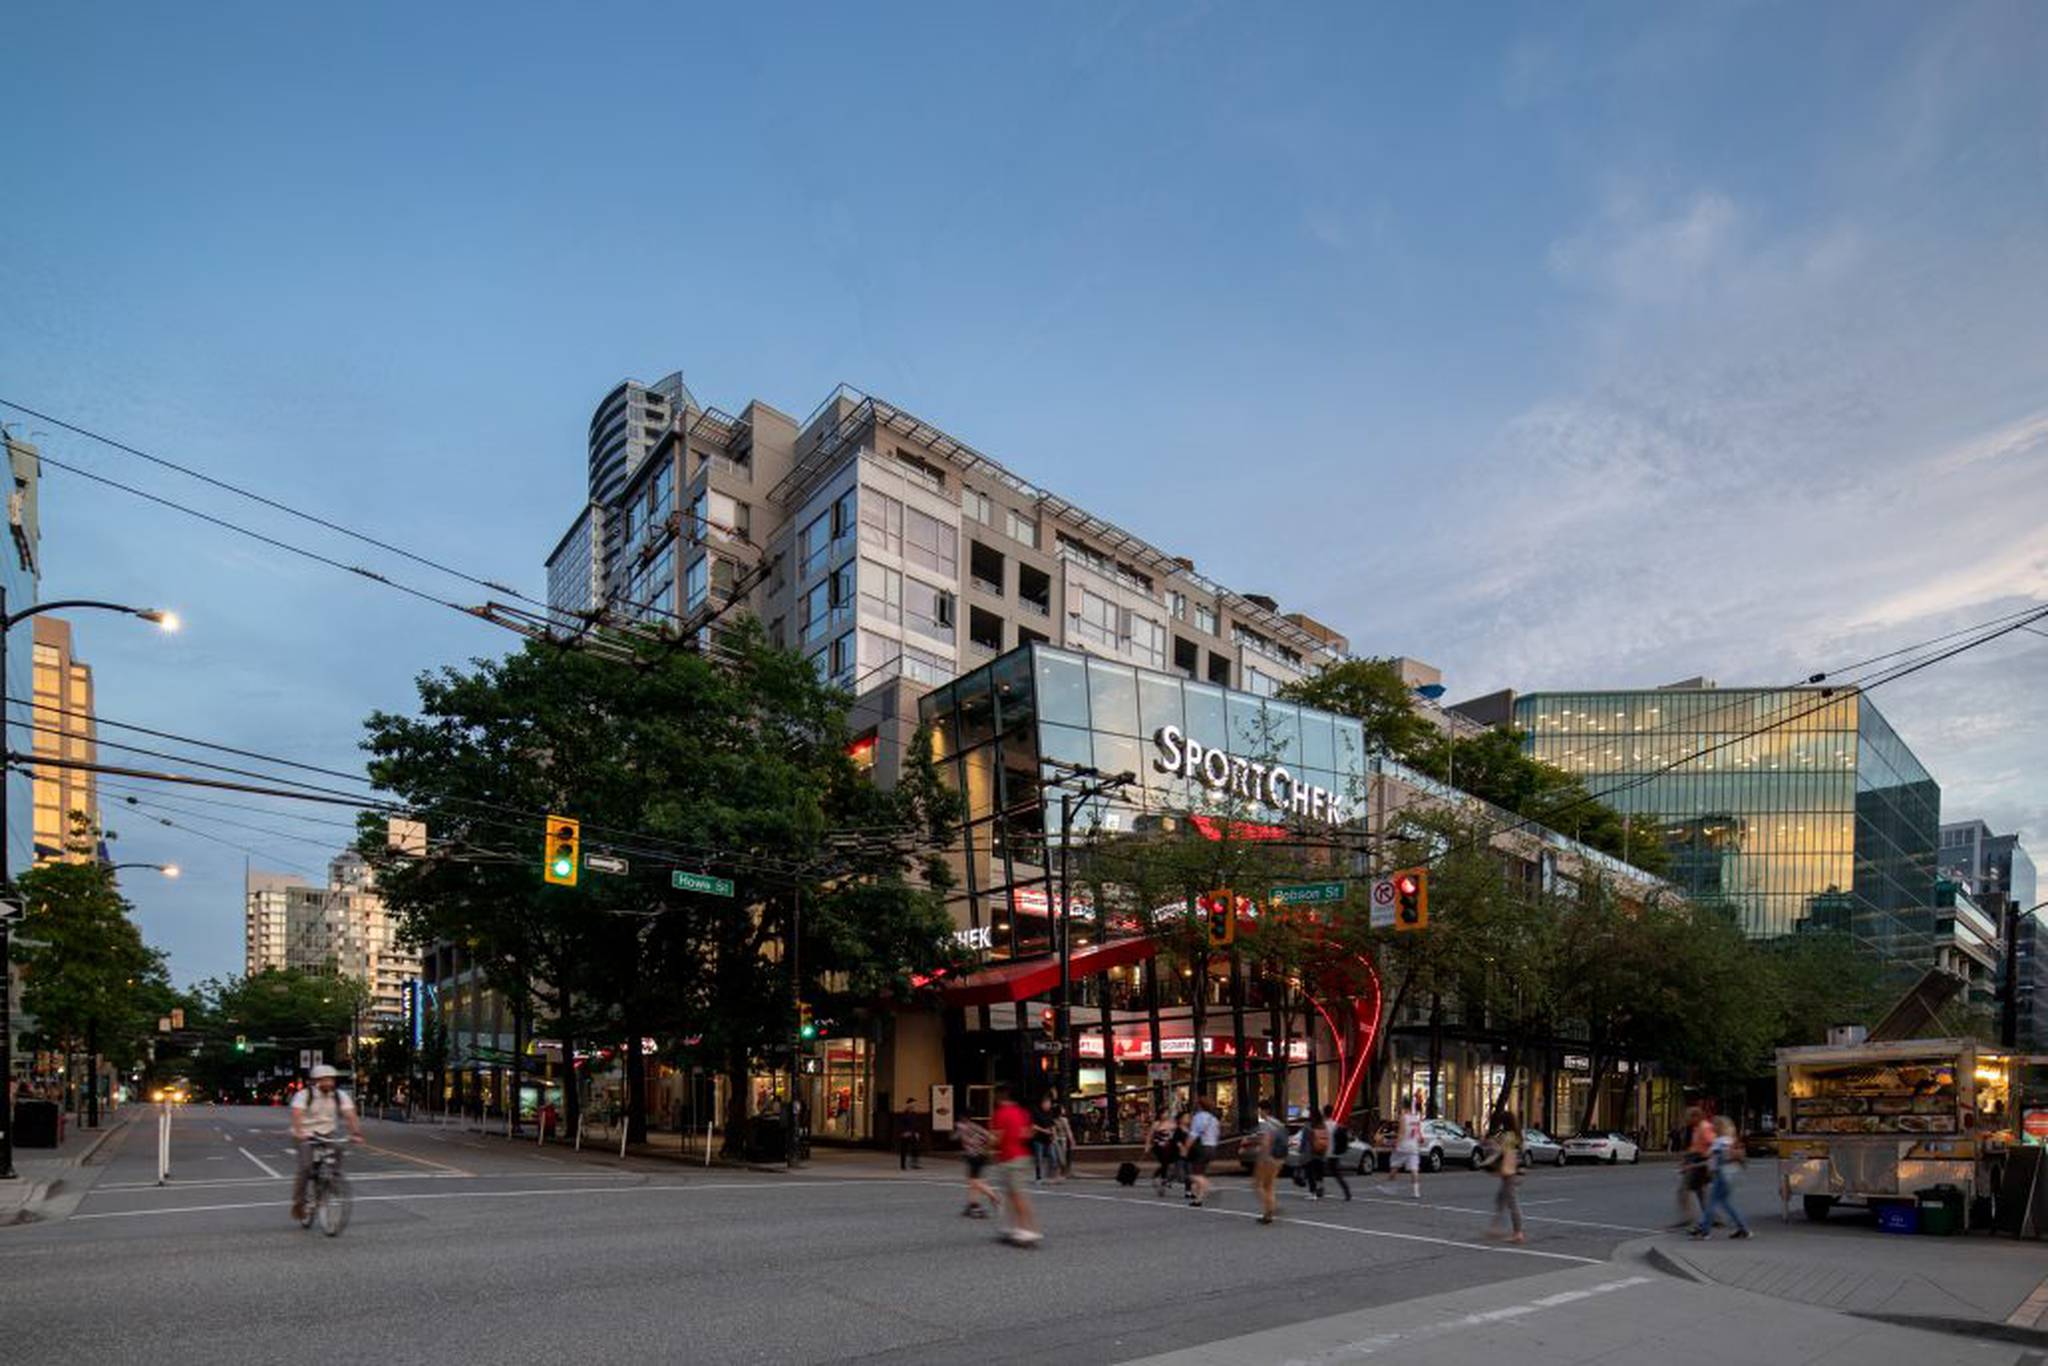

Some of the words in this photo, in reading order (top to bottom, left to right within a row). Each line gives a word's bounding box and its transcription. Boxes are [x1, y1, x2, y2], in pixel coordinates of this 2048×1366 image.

[679, 874, 710, 890] Howe
[715, 880, 729, 893] St
[1275, 888, 1320, 902] Robson
[1325, 885, 1340, 898] St
